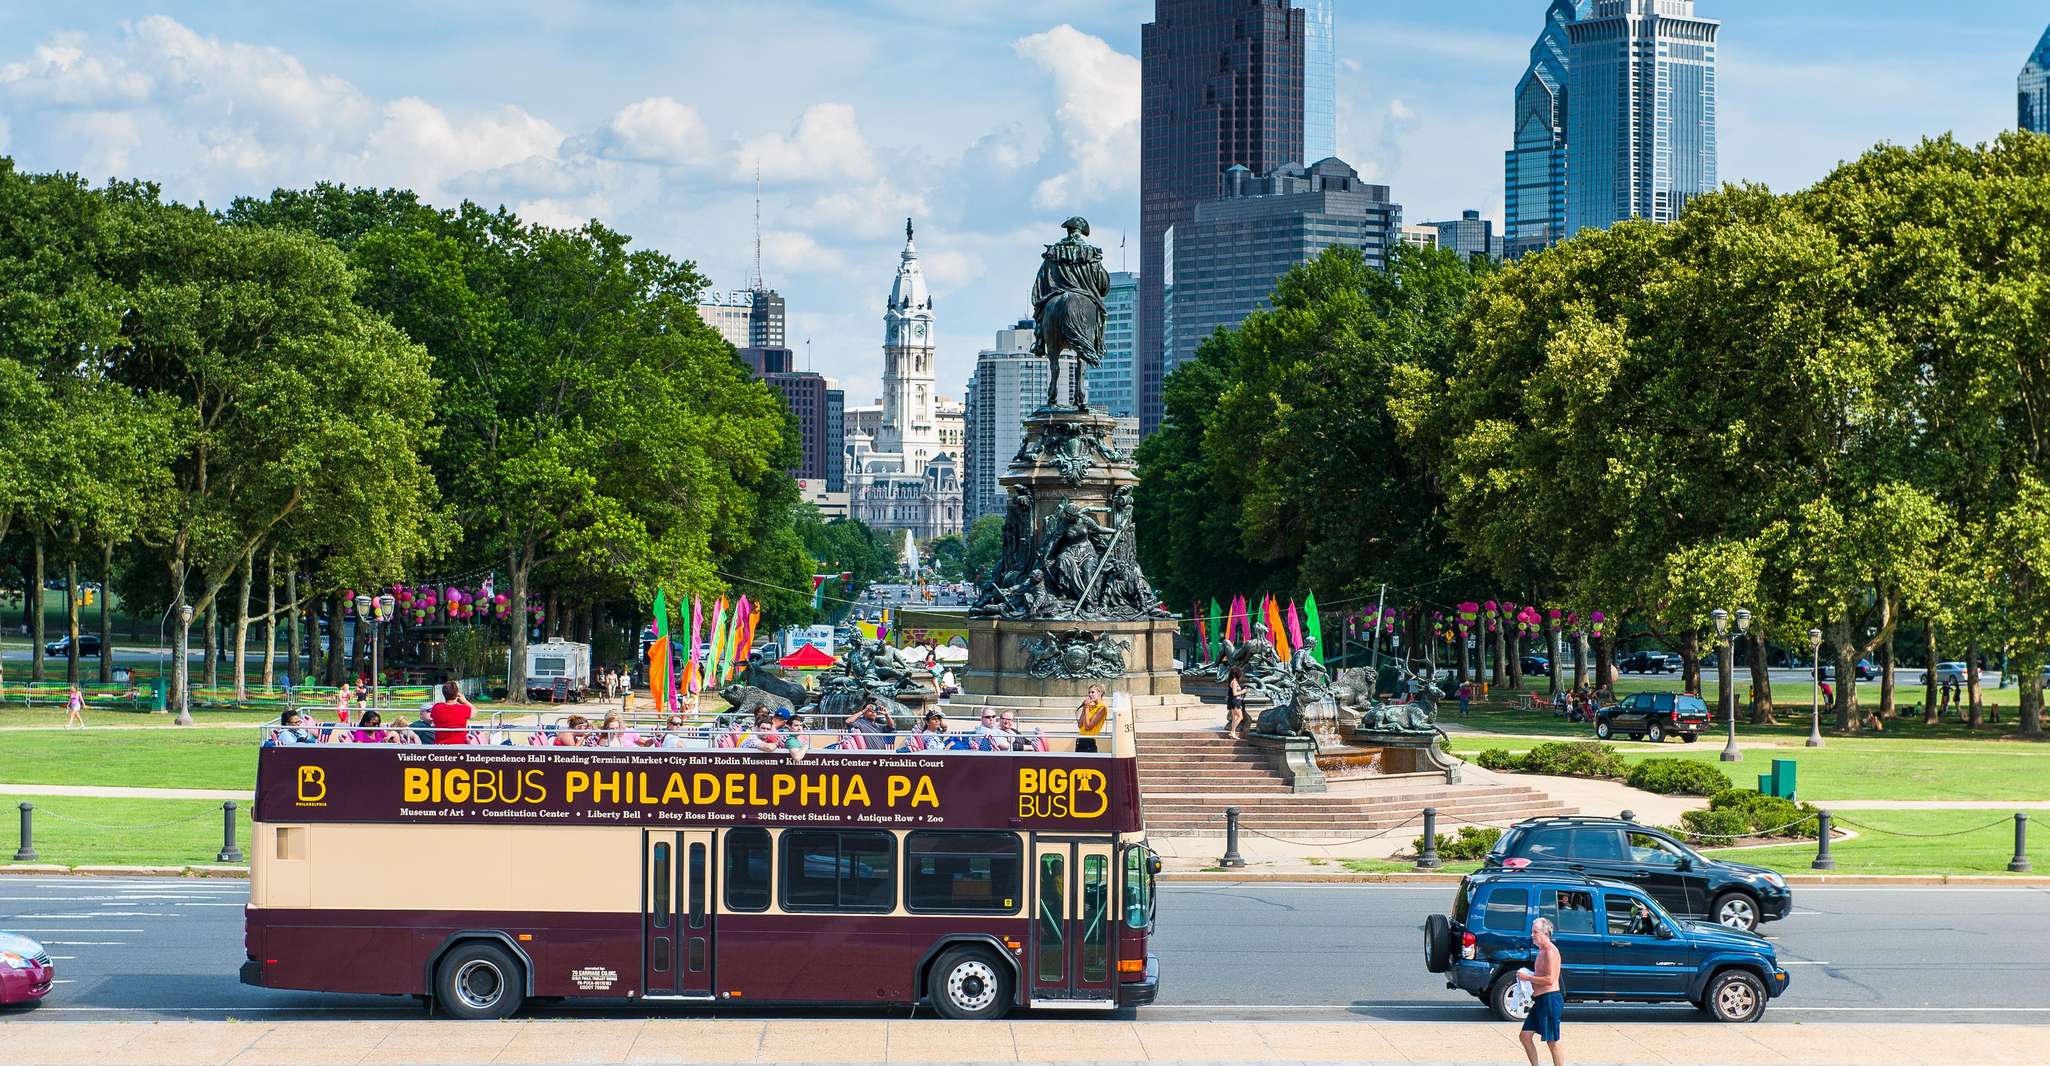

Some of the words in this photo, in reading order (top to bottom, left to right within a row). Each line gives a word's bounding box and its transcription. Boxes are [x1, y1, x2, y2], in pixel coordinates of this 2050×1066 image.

[699, 289, 754, 308] PSFS
[396, 752, 427, 762] Visitor
[428, 753, 458, 763] Center
[466, 754, 526, 765] Independence
[528, 755, 546, 764] Hall
[554, 755, 590, 766] Reading
[591, 756, 629, 765] Terminal
[631, 756, 663, 766] Market
[669, 757, 688, 767] City
[689, 757, 707, 767] Hall
[713, 757, 741, 767] Rodin
[742, 757, 779, 767] Museum
[821, 758, 840, 767] Arts
[841, 759, 872, 767] Center
[879, 759, 918, 769] Franklin
[919, 760, 945, 769] Court
[566, 771, 871, 807] PHILADELPHIA
[887, 774, 940, 808] PA
[1019, 768, 1068, 794] BIG
[399, 808, 437, 817] Museum
[439, 808, 449, 817] of
[450, 809, 465, 817] Art
[482, 809, 538, 818] Constitution
[540, 810, 571, 819] Center
[587, 810, 620, 821] Liberty
[623, 811, 641, 820] Bell
[658, 811, 683, 822] Betsy
[685, 812, 706, 821] Ross
[708, 812, 736, 821] House
[757, 812, 777, 821] 30th
[779, 813, 807, 822] Street
[808, 813, 841, 822] Station
[857, 814, 893, 824] Antique
[895, 814, 915, 823] Row
[926, 814, 944, 823] Zoo
[1019, 794, 1068, 818] BUS
